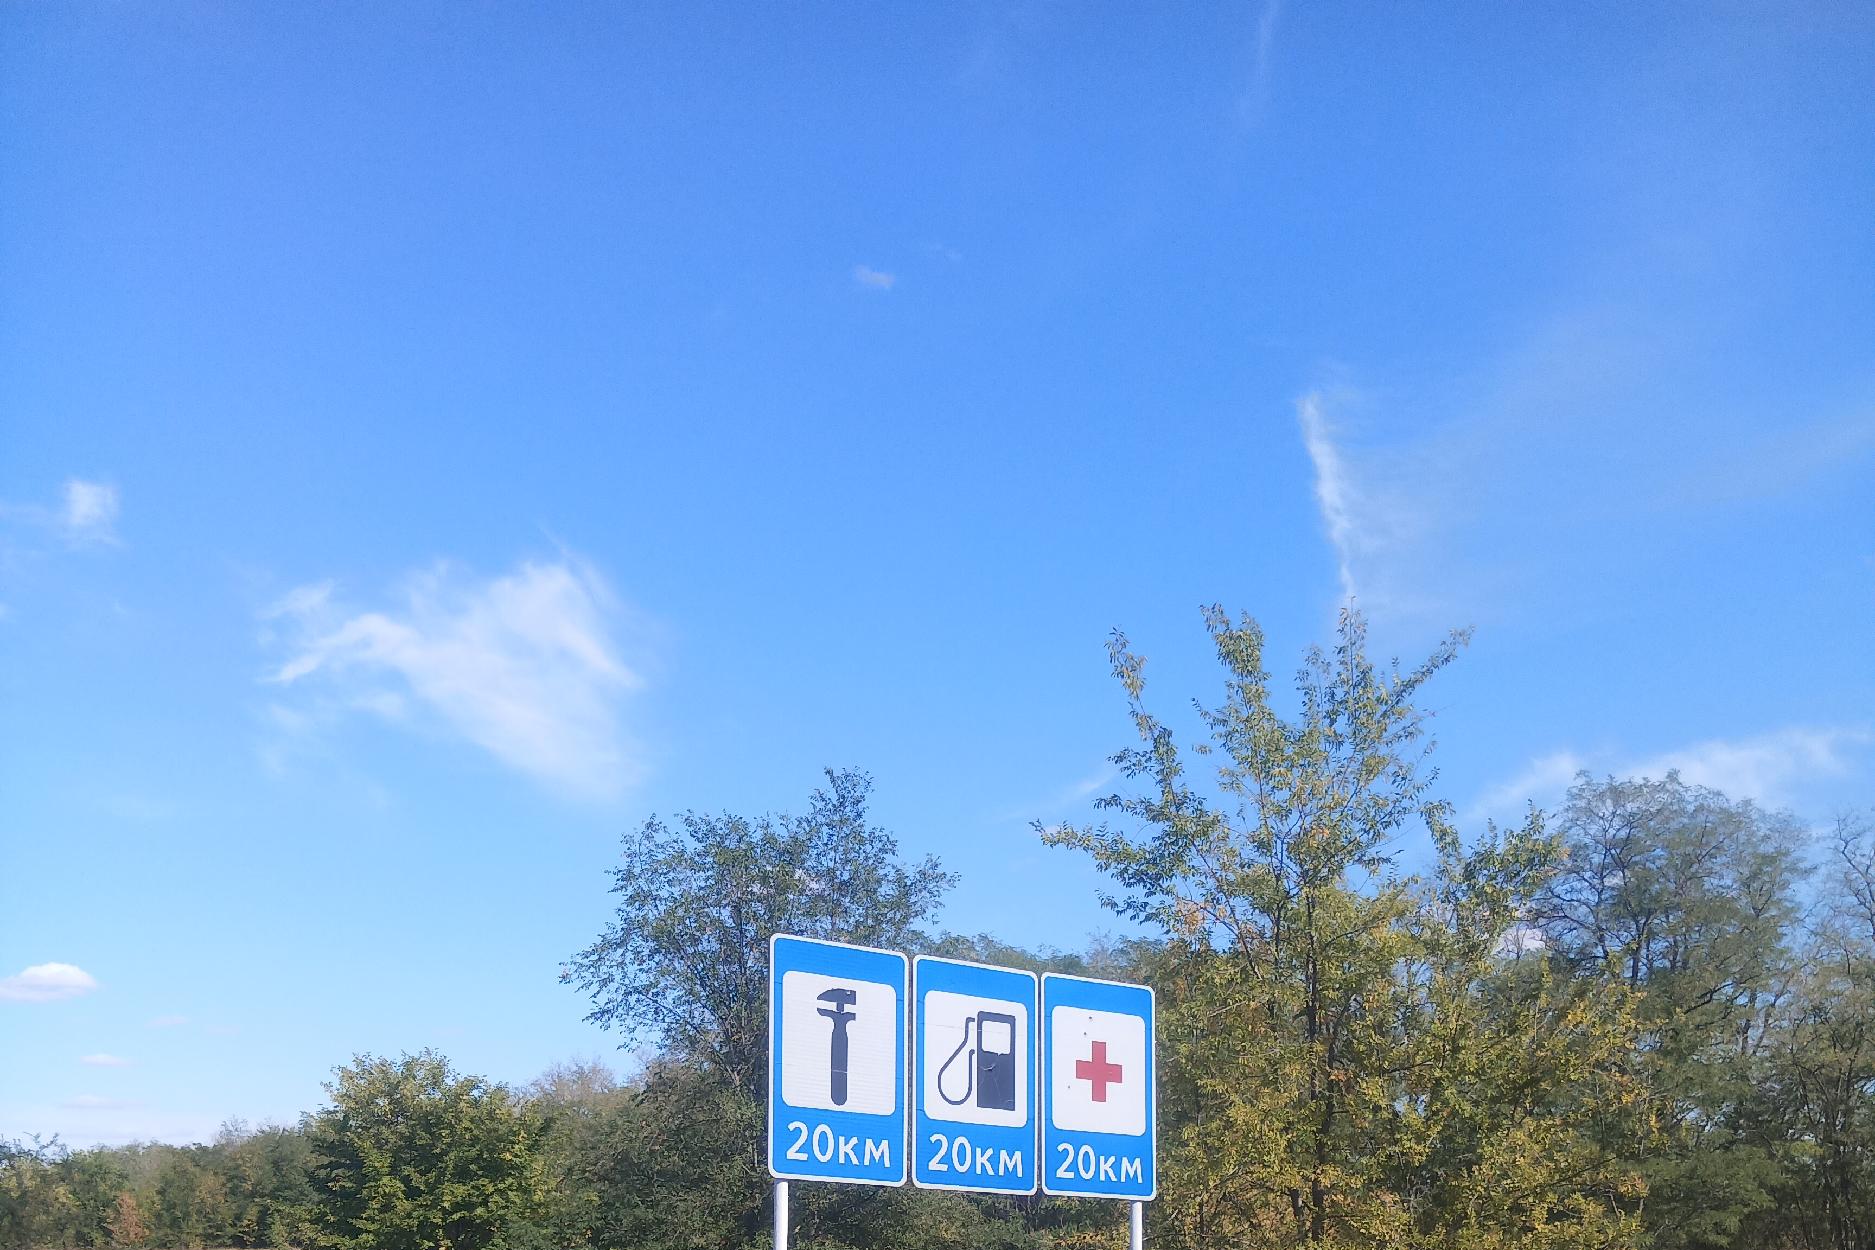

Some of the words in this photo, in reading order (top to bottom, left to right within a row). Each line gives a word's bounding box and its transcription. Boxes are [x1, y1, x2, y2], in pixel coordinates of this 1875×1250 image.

[785, 1120, 892, 1168] 20км
[927, 1133, 1024, 1178] 20км
[1055, 1142, 1144, 1184] 20км
